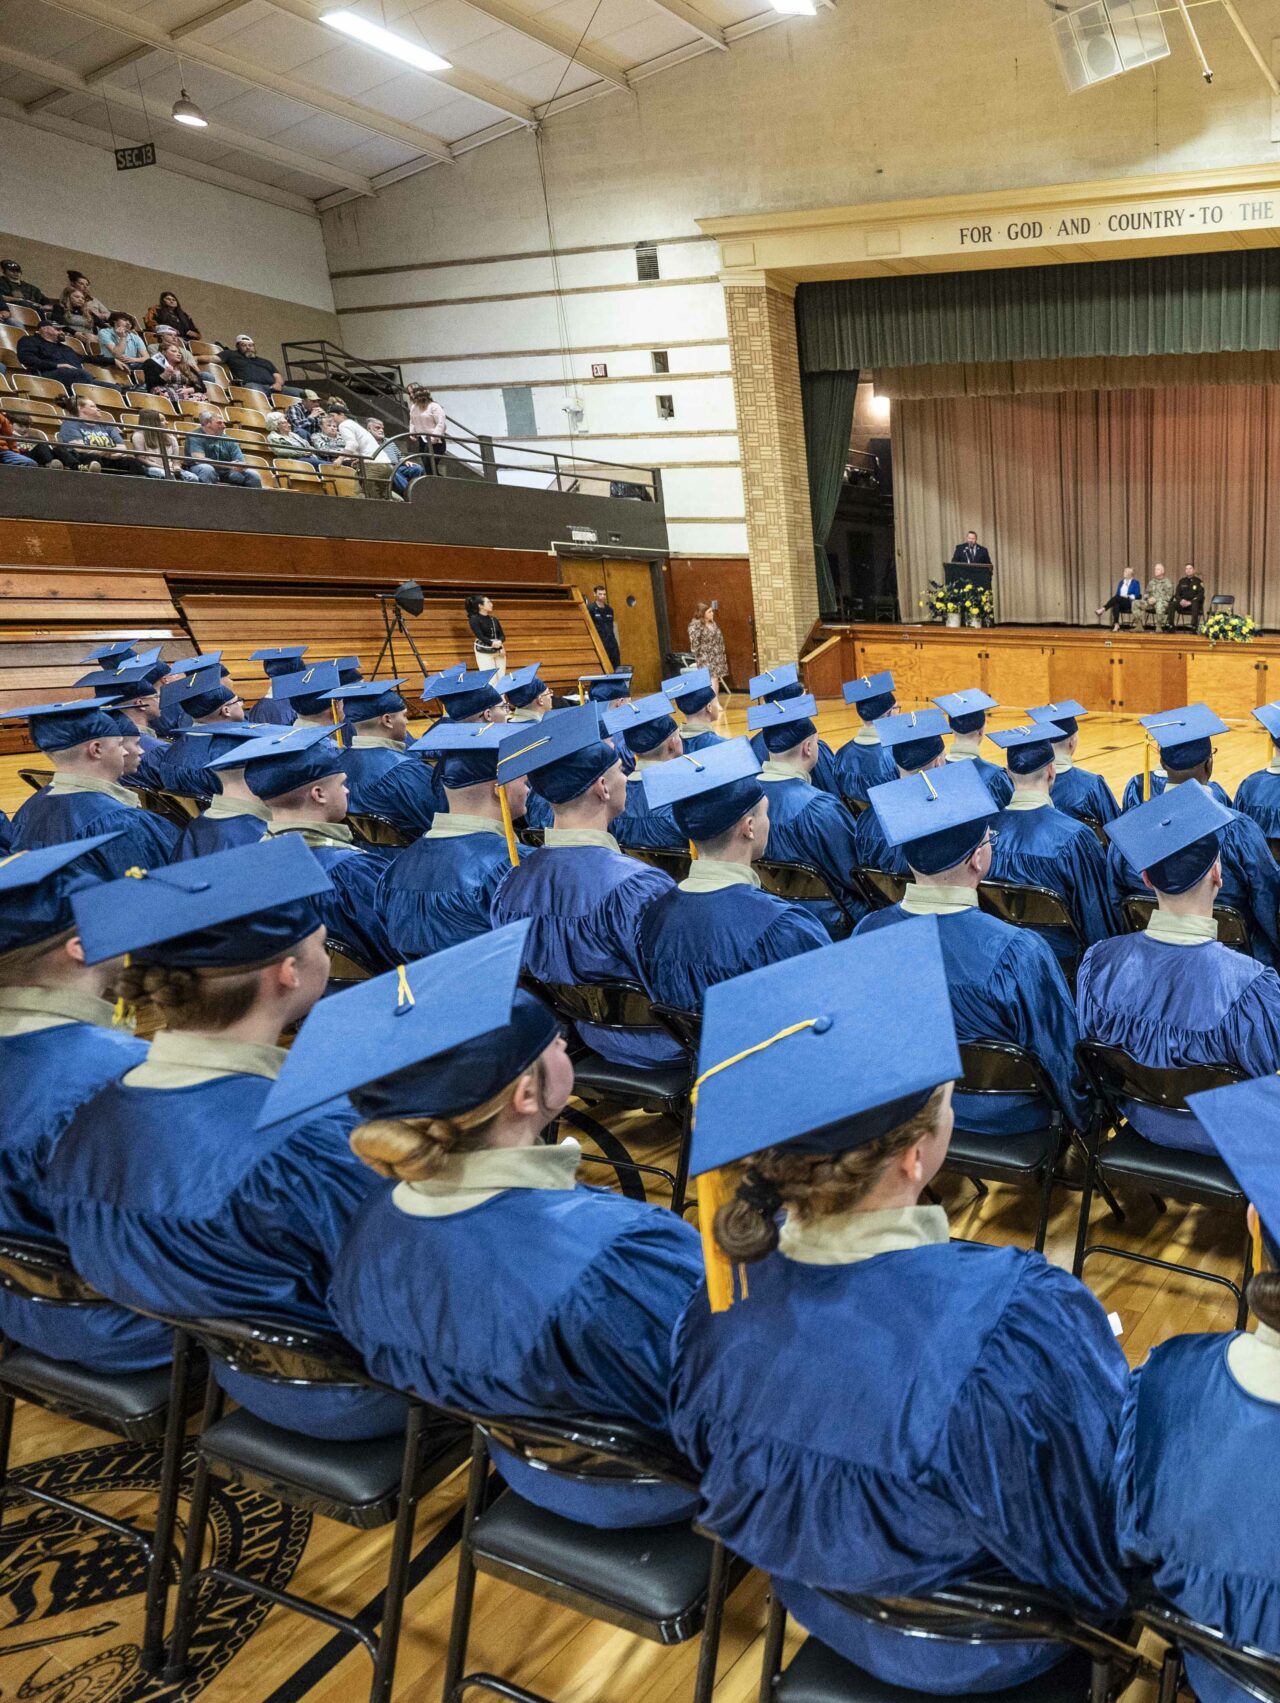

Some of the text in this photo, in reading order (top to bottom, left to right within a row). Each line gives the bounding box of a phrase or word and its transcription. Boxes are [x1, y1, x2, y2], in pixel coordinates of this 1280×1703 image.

[959, 225, 992, 245] FOR
[1007, 221, 1043, 241] GOD
[1057, 217, 1091, 237] AND
[1239, 201, 1274, 221] THE
